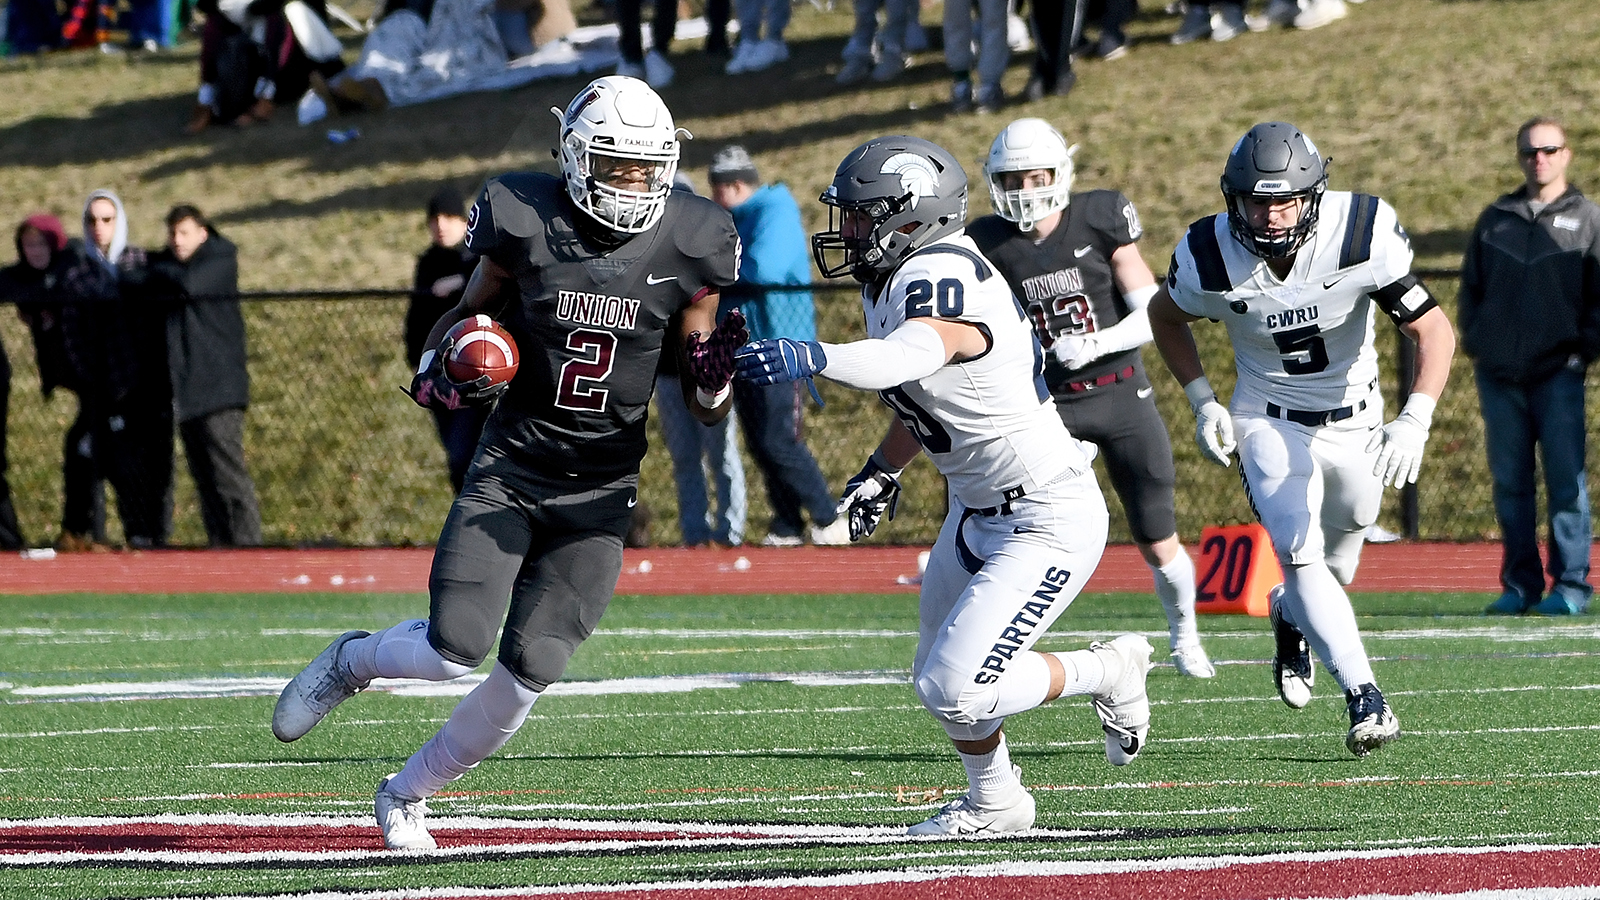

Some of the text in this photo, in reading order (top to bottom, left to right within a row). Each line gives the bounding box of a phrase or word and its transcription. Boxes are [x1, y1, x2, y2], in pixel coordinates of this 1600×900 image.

[905, 278, 965, 318] 20
[1022, 266, 1085, 301] UNION
[556, 290, 642, 331] UNION
[1027, 293, 1098, 351] 13
[1266, 304, 1320, 330] CWRU
[554, 328, 618, 413] 2
[1272, 324, 1330, 375] 5
[1009, 489, 1019, 499] M
[1195, 534, 1253, 603] 20
[974, 566, 1071, 685] SPARTANS
